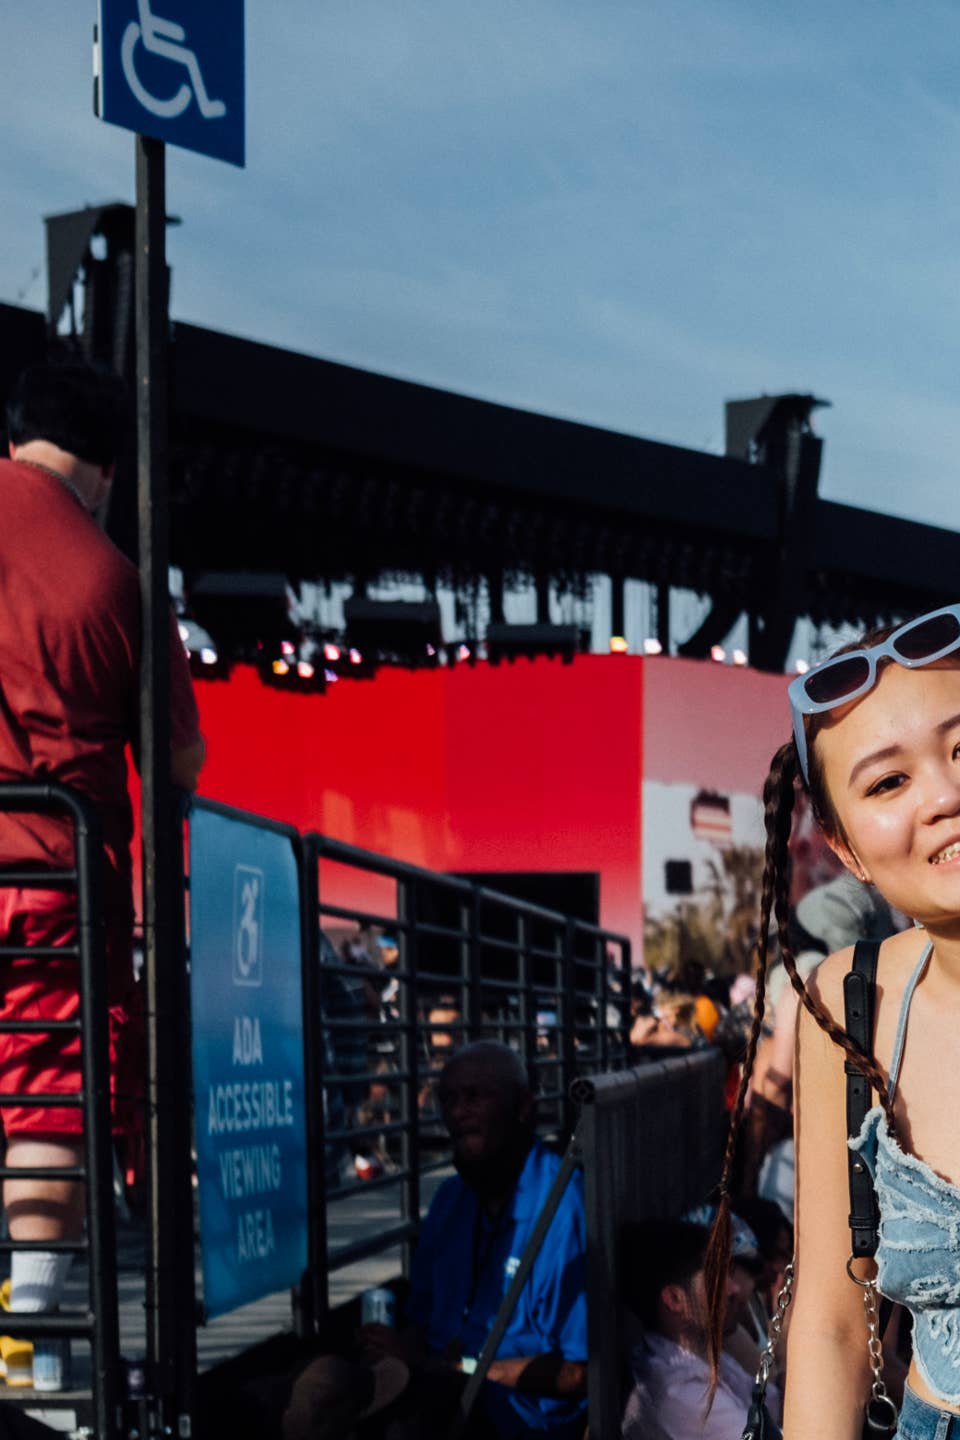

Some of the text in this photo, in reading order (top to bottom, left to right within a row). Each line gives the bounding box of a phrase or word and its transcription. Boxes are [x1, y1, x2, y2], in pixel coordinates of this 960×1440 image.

[232, 1016, 263, 1066] ADA
[207, 1080, 293, 1136] ACCESSIBLE
[219, 1144, 282, 1199] VIEWING
[237, 1208, 276, 1264] AREA
